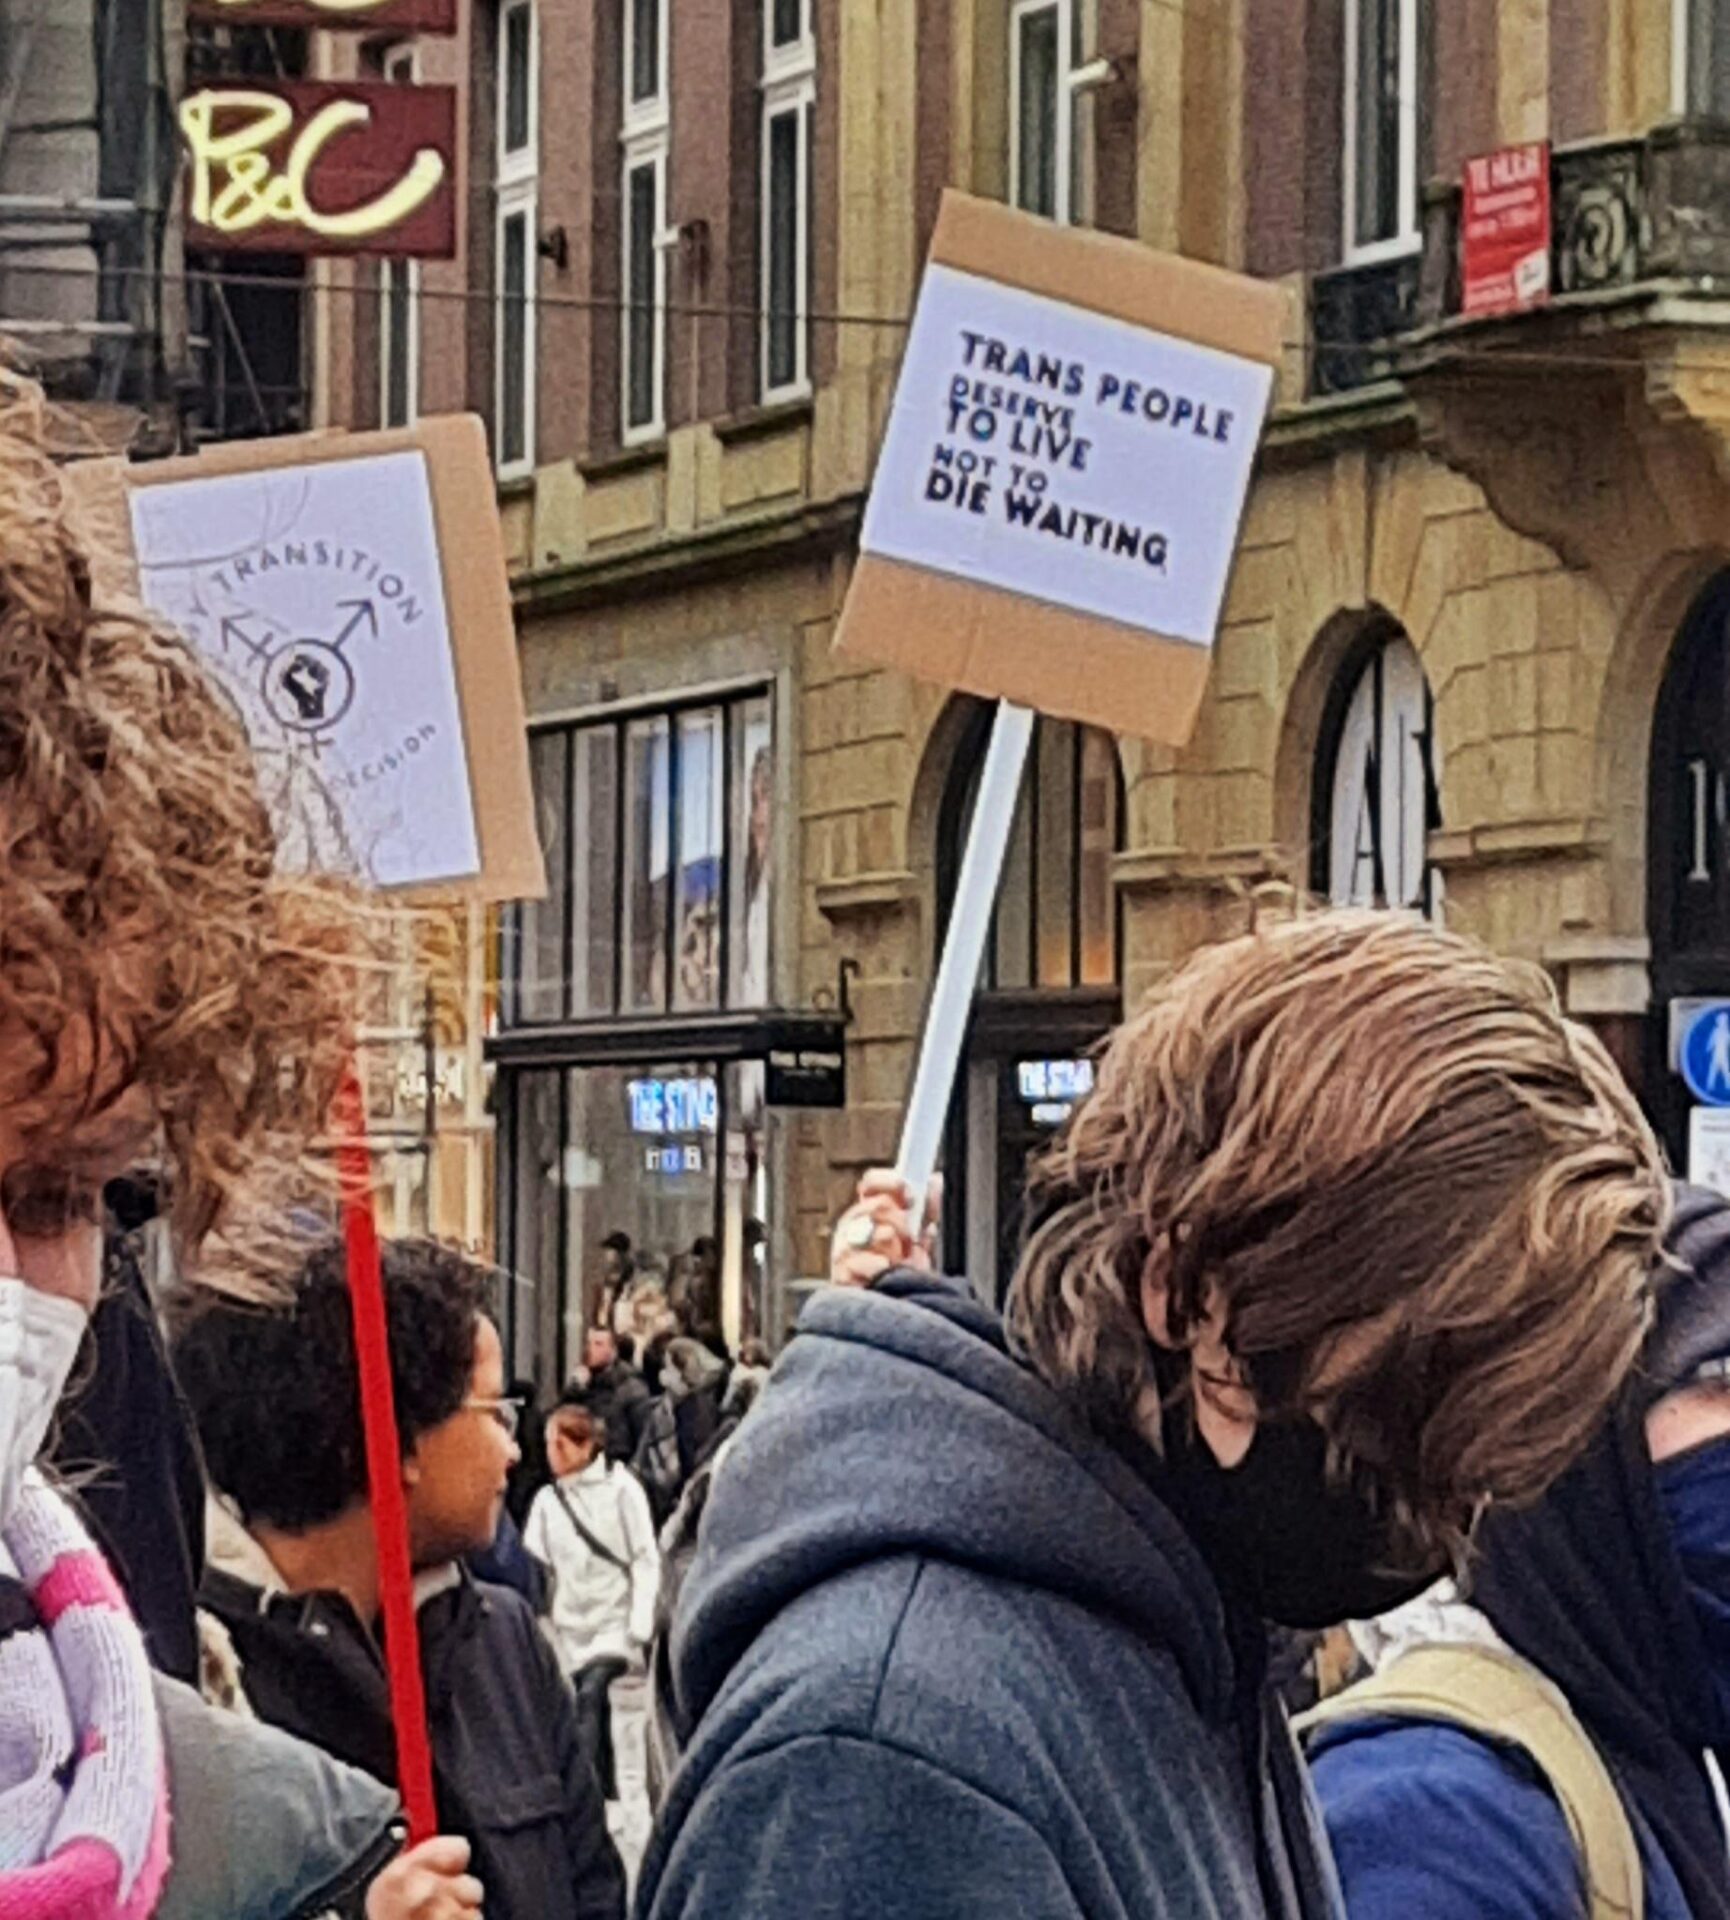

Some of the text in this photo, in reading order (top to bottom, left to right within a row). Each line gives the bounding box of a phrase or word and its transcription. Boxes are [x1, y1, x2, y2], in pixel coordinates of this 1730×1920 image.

[178, 89, 445, 235] P&C
[949, 376, 1076, 430] DESERVE
[959, 331, 1234, 444] TRANS PEOPLE
[934, 444, 1049, 493] NOT TO
[944, 400, 1094, 471] TO LIVE
[925, 469, 1169, 569] DIE WAITING
[212, 540, 424, 627] TRANSITION
